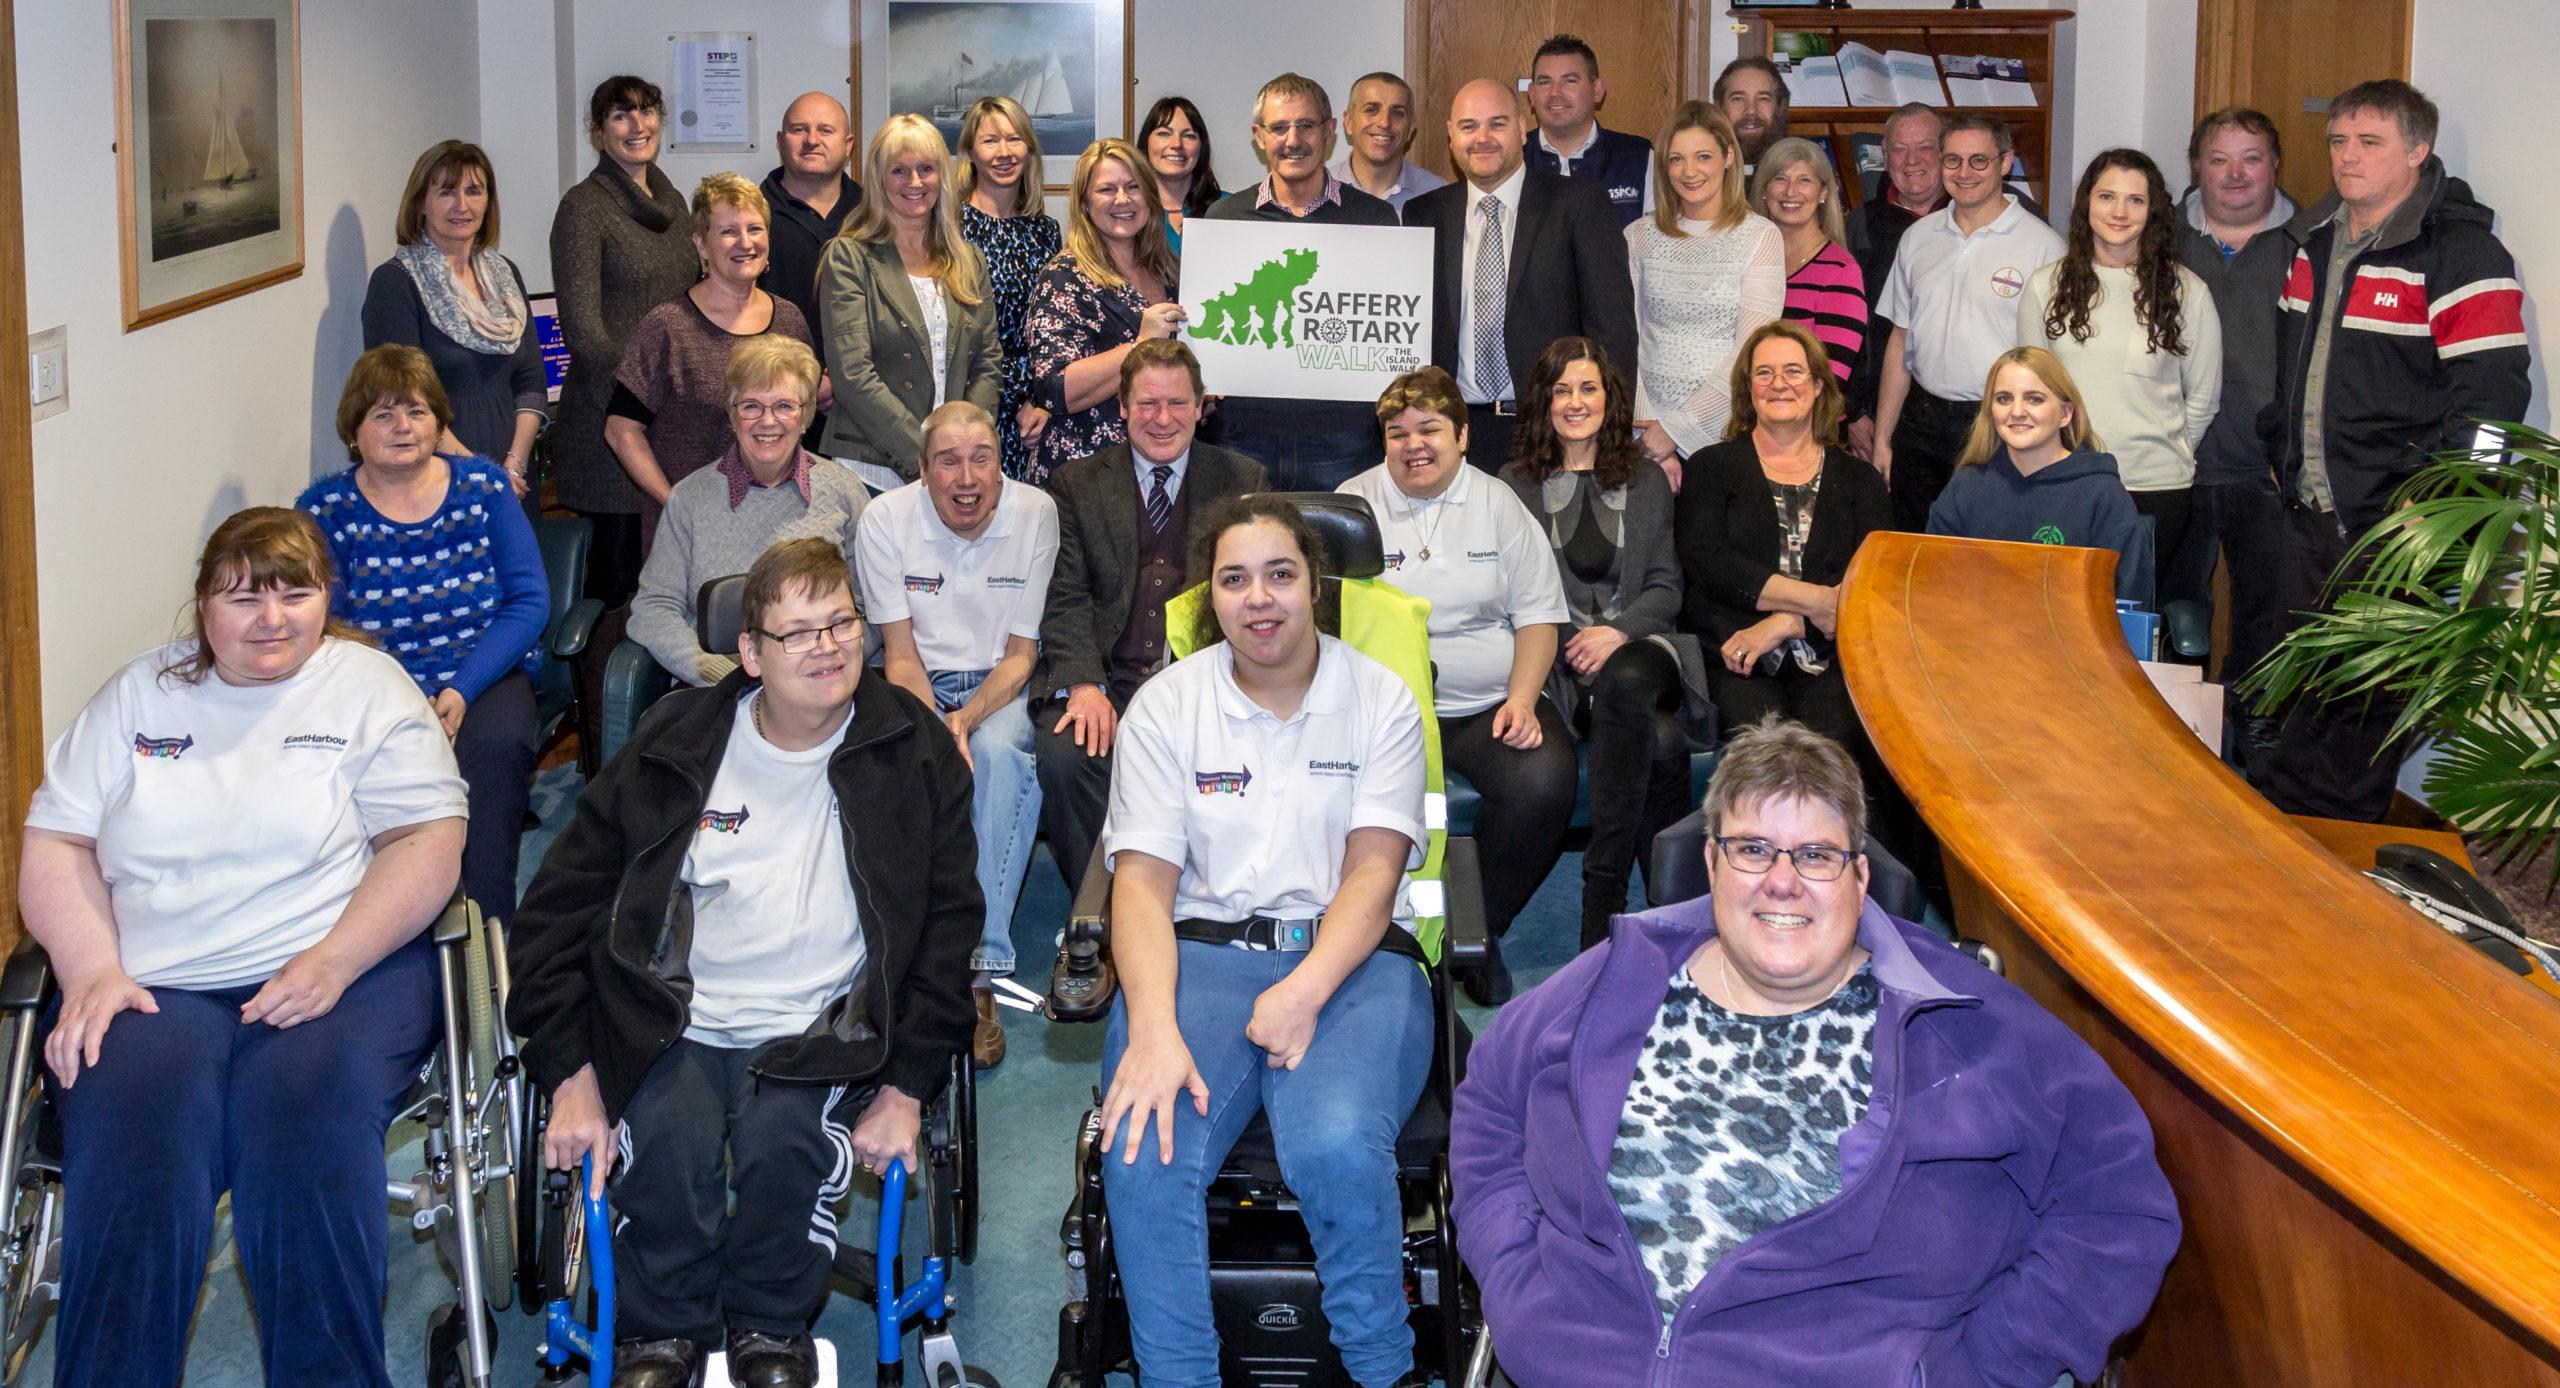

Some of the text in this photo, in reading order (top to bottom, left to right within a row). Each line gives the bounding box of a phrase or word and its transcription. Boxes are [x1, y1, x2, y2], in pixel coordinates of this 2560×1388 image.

[707, 52, 730, 60] STEP
[1298, 290, 1421, 317] SAFFERY
[2373, 291, 2399, 308] HH
[1303, 317, 1421, 344] ROTARY
[1393, 347, 1413, 356] THE
[1296, 343, 1389, 372] WALK
[1385, 355, 1420, 365] ISLAND
[1389, 364, 1416, 373] WALK
[284, 734, 349, 746] EastHarbour
[1259, 1315, 1298, 1325] QUICKIE
